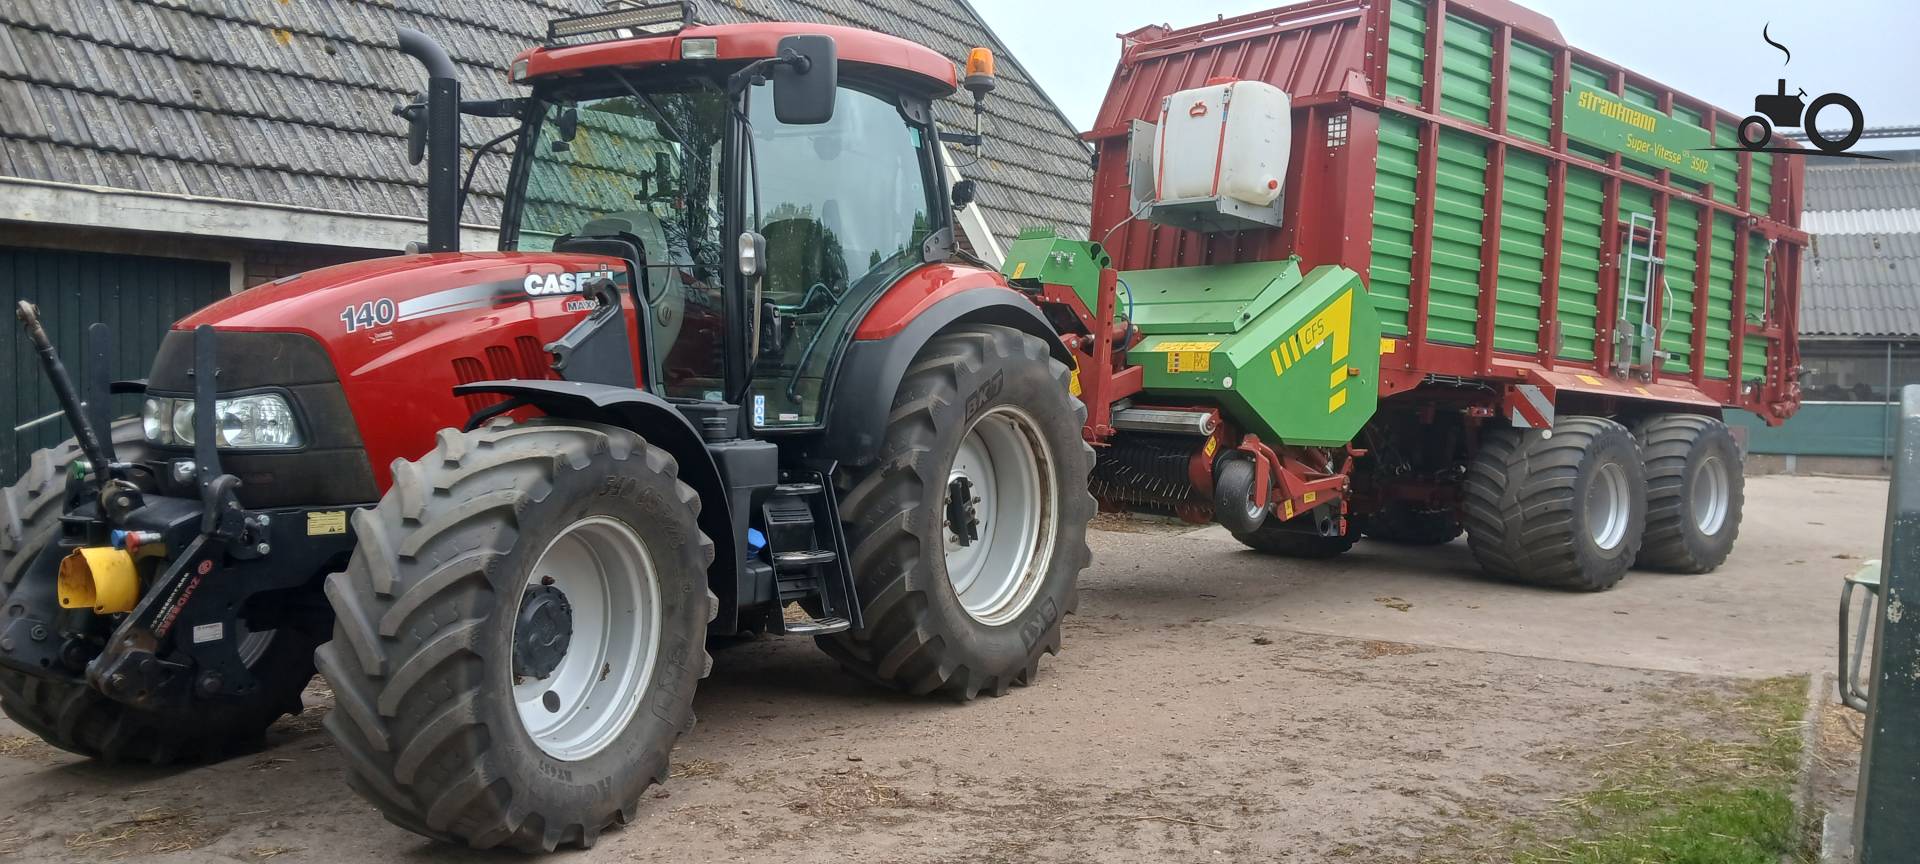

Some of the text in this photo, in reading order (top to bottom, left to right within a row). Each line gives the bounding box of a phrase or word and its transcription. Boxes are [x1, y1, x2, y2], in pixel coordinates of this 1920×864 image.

[1578, 91, 1657, 133] strautmann
[1626, 133, 1682, 164] Super-Vitesse
[340, 297, 395, 334] 140
[1304, 317, 1325, 345] CFS
